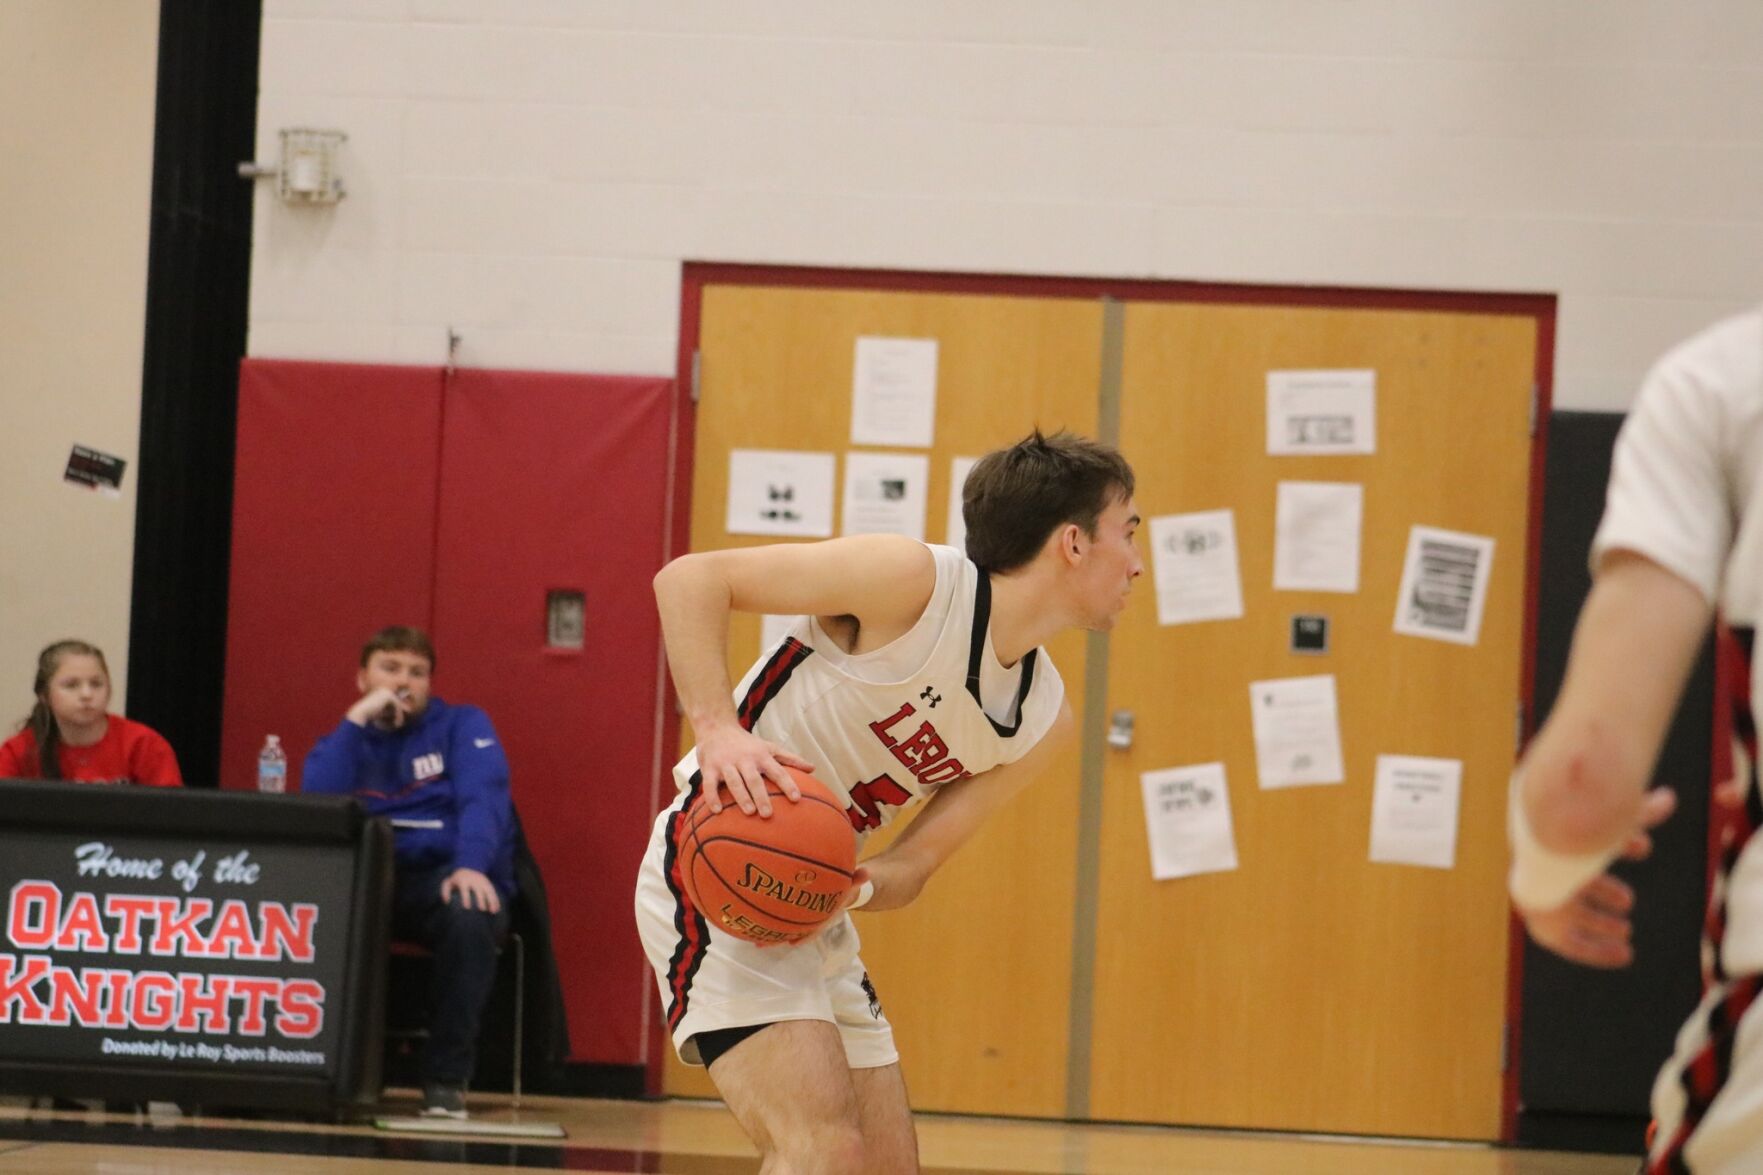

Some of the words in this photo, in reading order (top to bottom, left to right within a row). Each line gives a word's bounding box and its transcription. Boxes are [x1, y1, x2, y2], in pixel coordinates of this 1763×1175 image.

[74, 842, 164, 880] Home
[171, 849, 206, 893] of
[213, 849, 261, 885] the
[736, 862, 843, 914] SPALDING
[7, 879, 318, 963] OATKAN
[0, 954, 326, 1038] KNIGHTS
[102, 1038, 160, 1057] Donated
[161, 1041, 177, 1060] by
[179, 1042, 196, 1058] Le
[197, 1042, 222, 1063] Roy
[223, 1044, 266, 1063] Sports
[268, 1046, 325, 1065] Boosters
